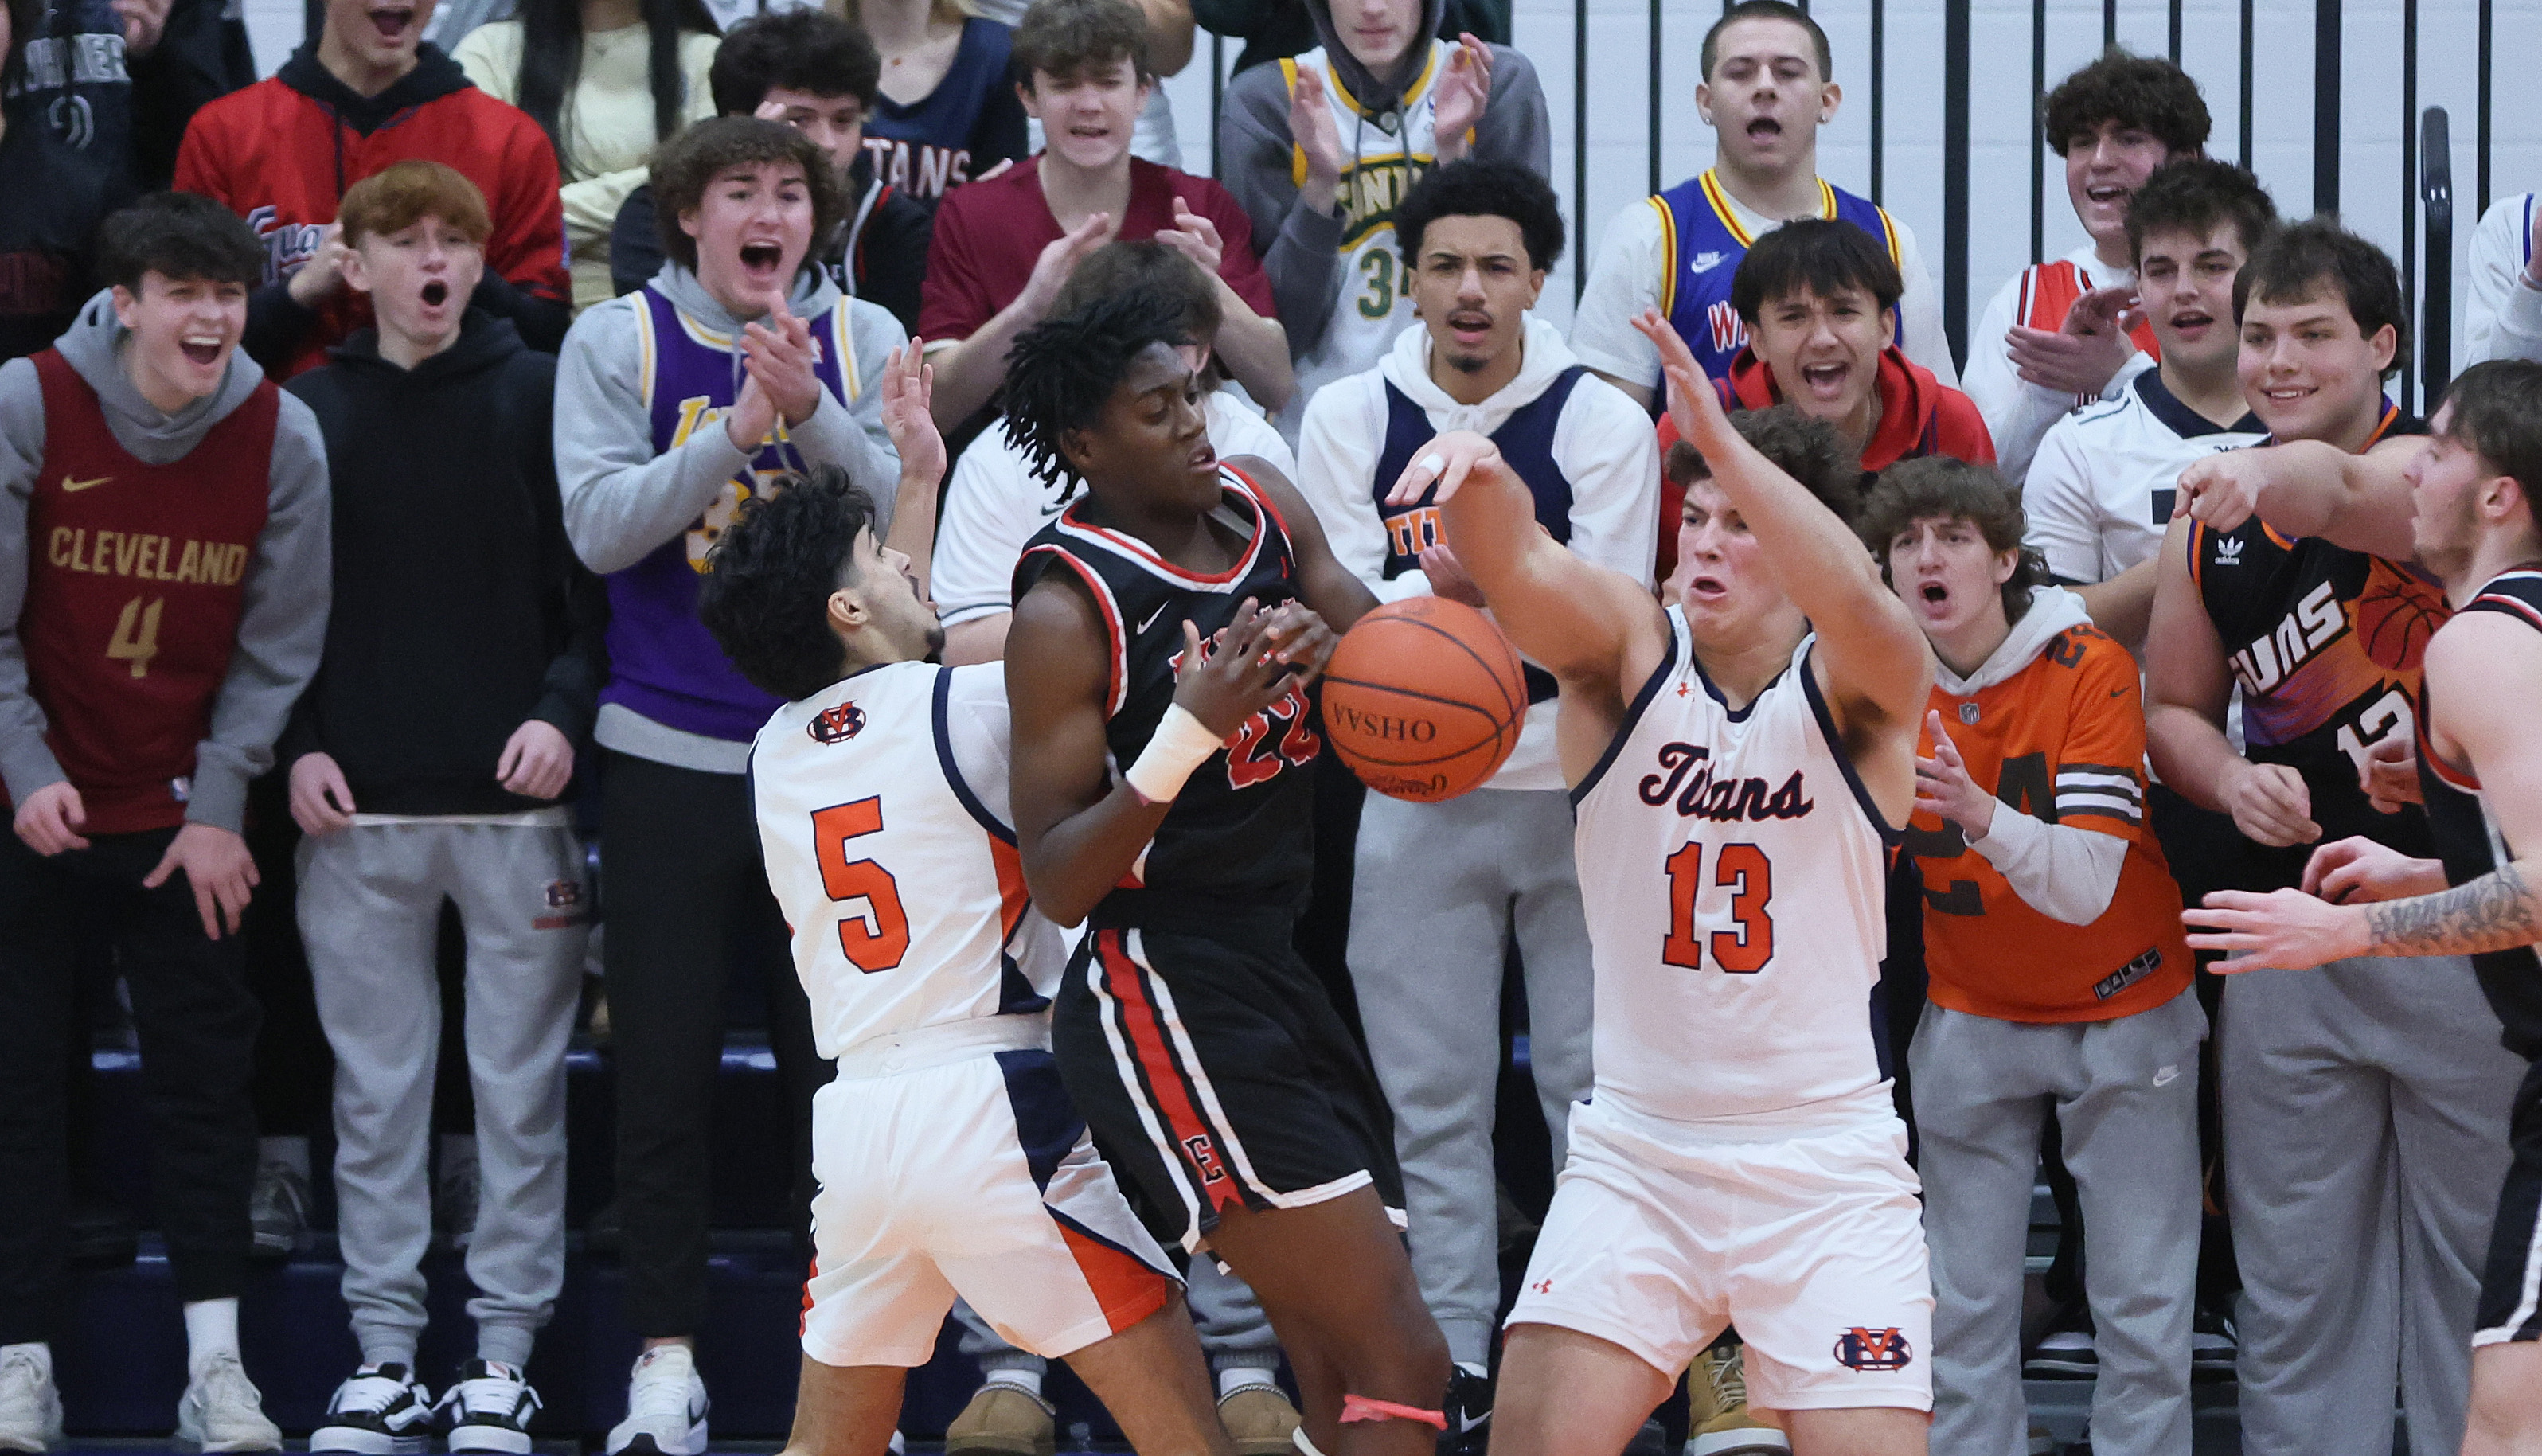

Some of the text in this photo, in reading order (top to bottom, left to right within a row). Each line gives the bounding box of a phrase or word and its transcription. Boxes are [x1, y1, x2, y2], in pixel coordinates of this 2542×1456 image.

[1357, 247, 1411, 319] 3
[49, 526, 248, 586] CLEVELAND
[105, 595, 165, 680] 4
[1221, 681, 1322, 790] 22
[810, 794, 911, 974] 5
[1662, 840, 1774, 974] 13
[1181, 1133, 1227, 1185] E
